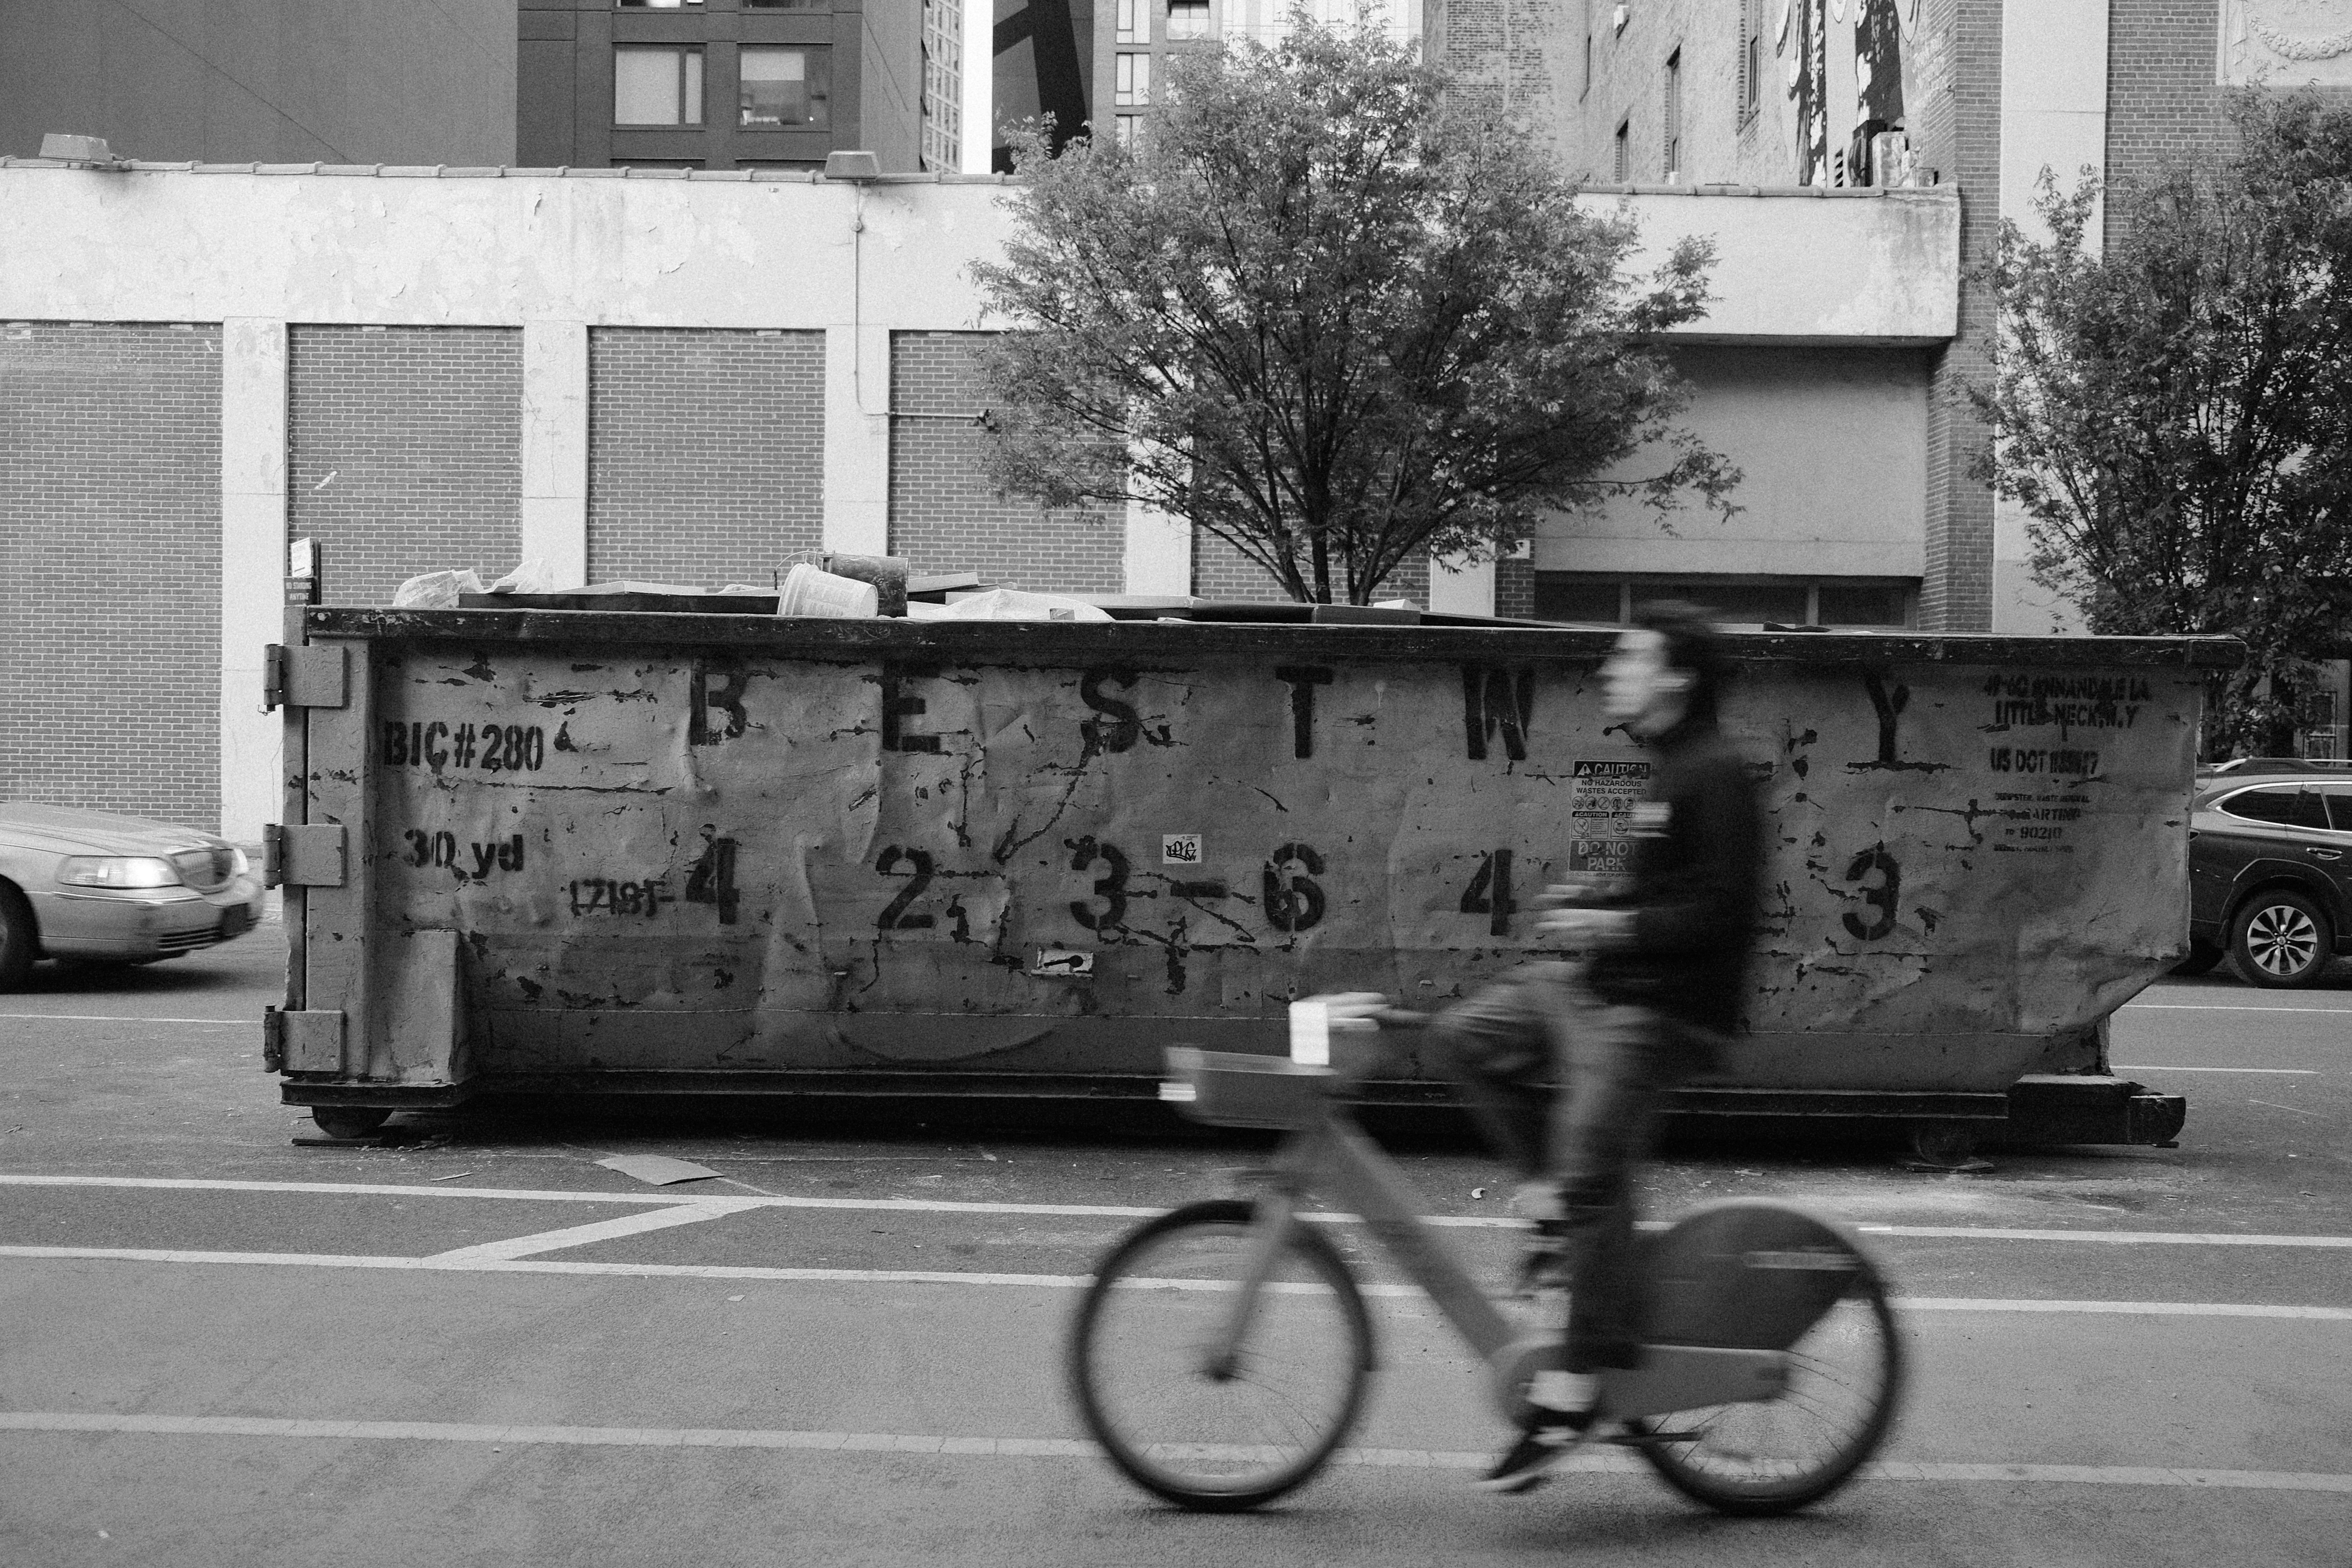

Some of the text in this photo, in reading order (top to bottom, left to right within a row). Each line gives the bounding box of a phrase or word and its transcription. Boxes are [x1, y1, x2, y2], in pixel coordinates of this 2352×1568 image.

[1995, 700, 2047, 726] LITTL
[384, 720, 544, 774] BIC#280
[1990, 747, 2011, 772] US
[2015, 750, 2048, 773] DOT
[472, 835, 523, 879] yd
[1578, 842, 1638, 856] DO NOT
[1587, 857, 1626, 871] PARK
